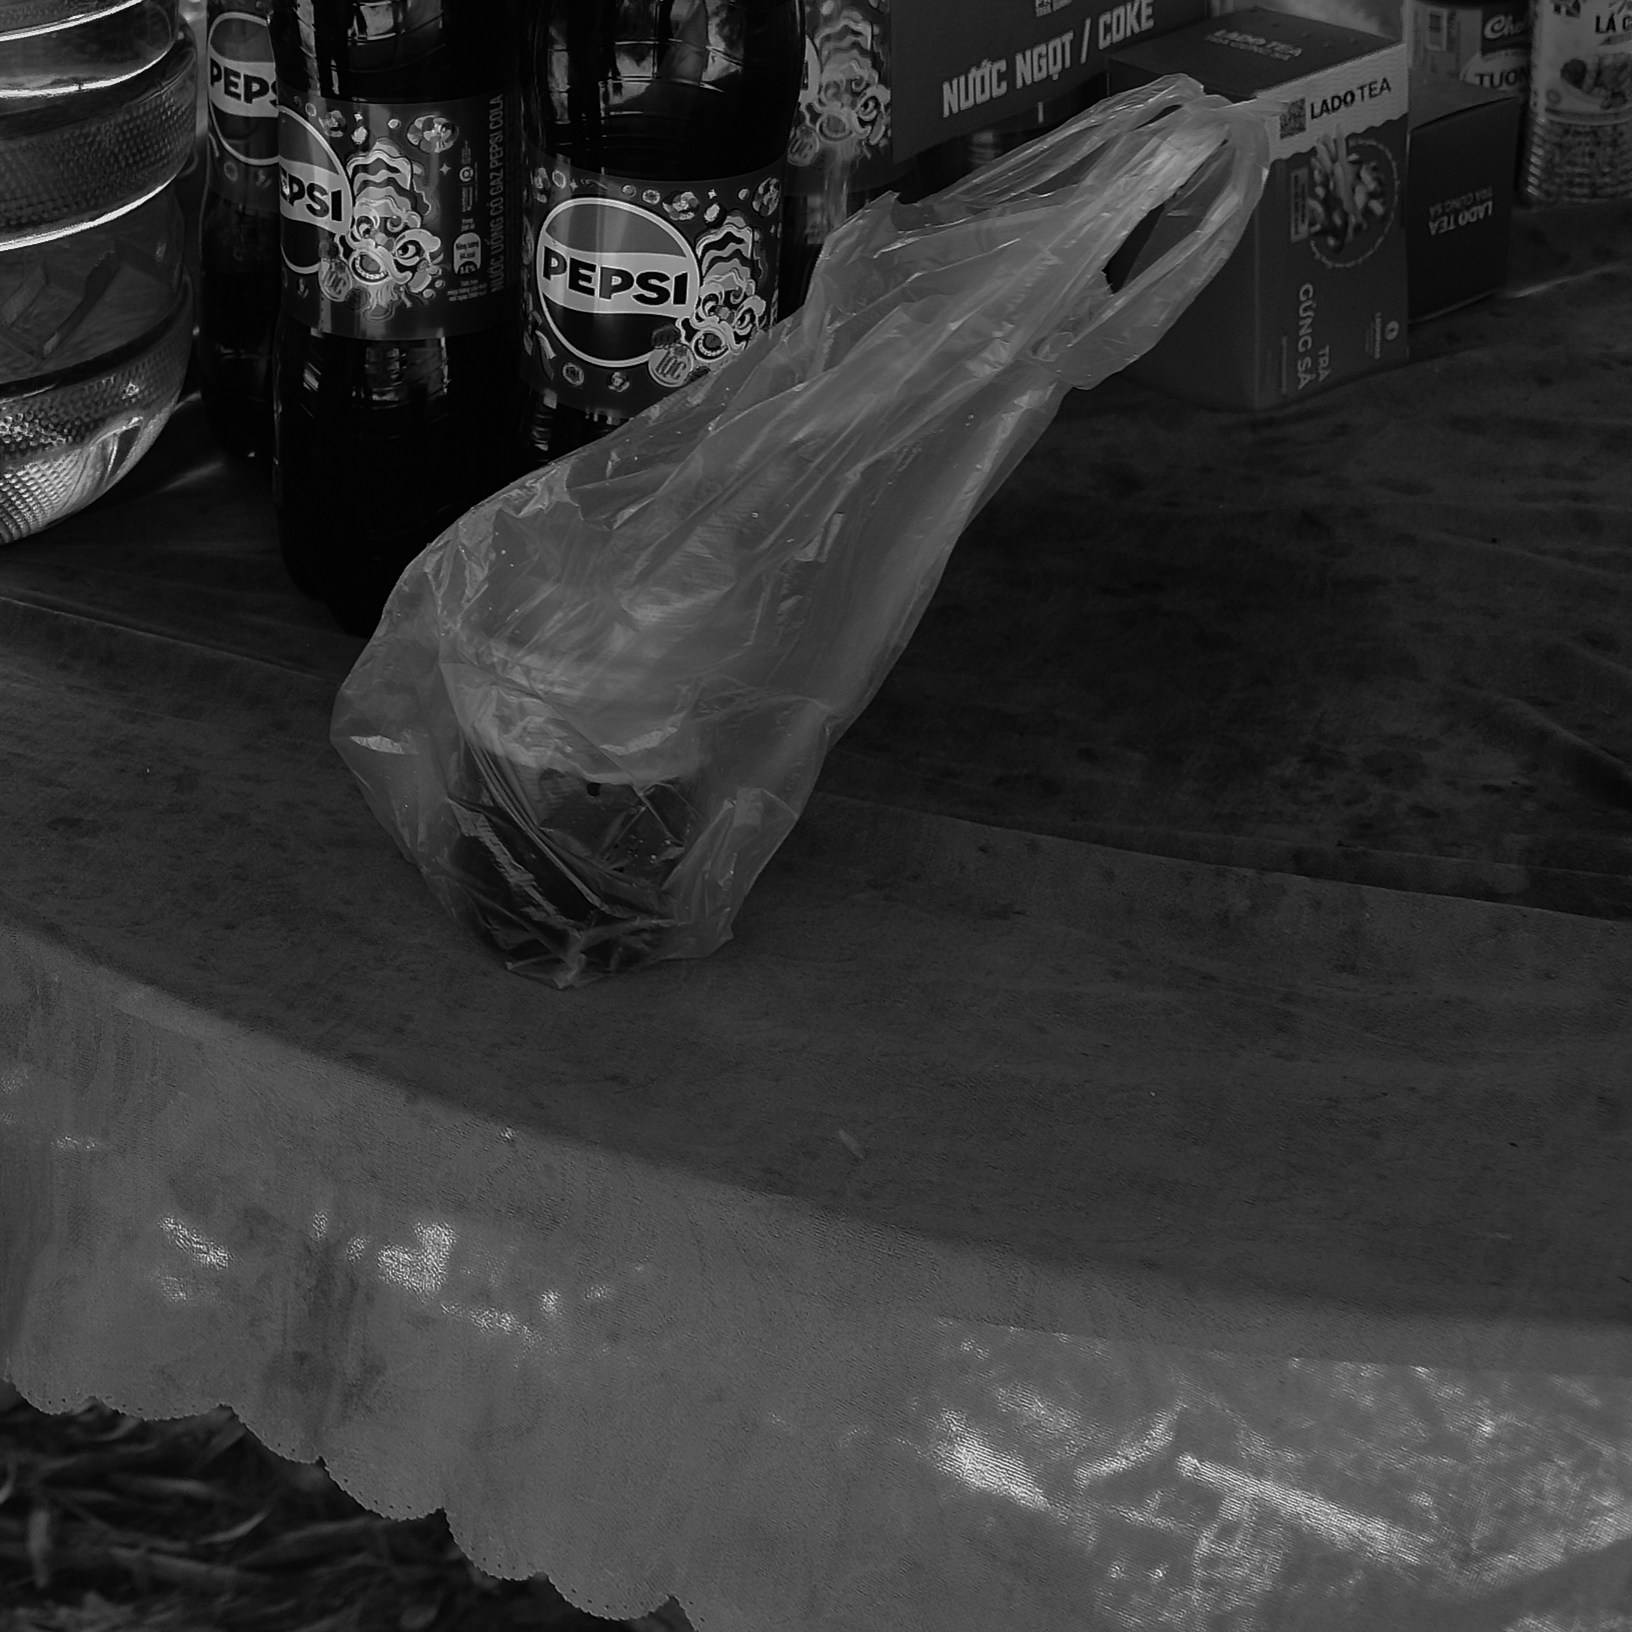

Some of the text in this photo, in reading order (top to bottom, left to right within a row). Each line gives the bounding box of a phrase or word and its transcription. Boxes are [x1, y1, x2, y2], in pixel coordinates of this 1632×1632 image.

[942, 57, 1007, 119] NƯỚC
[1015, 29, 1075, 90] NGỌT
[488, 93, 505, 131] COLA
[1309, 76, 1392, 120] LADO TEA
[488, 132, 505, 167] PEPSI
[488, 168, 505, 194] GAZ
[542, 245, 689, 307] PEPSI
